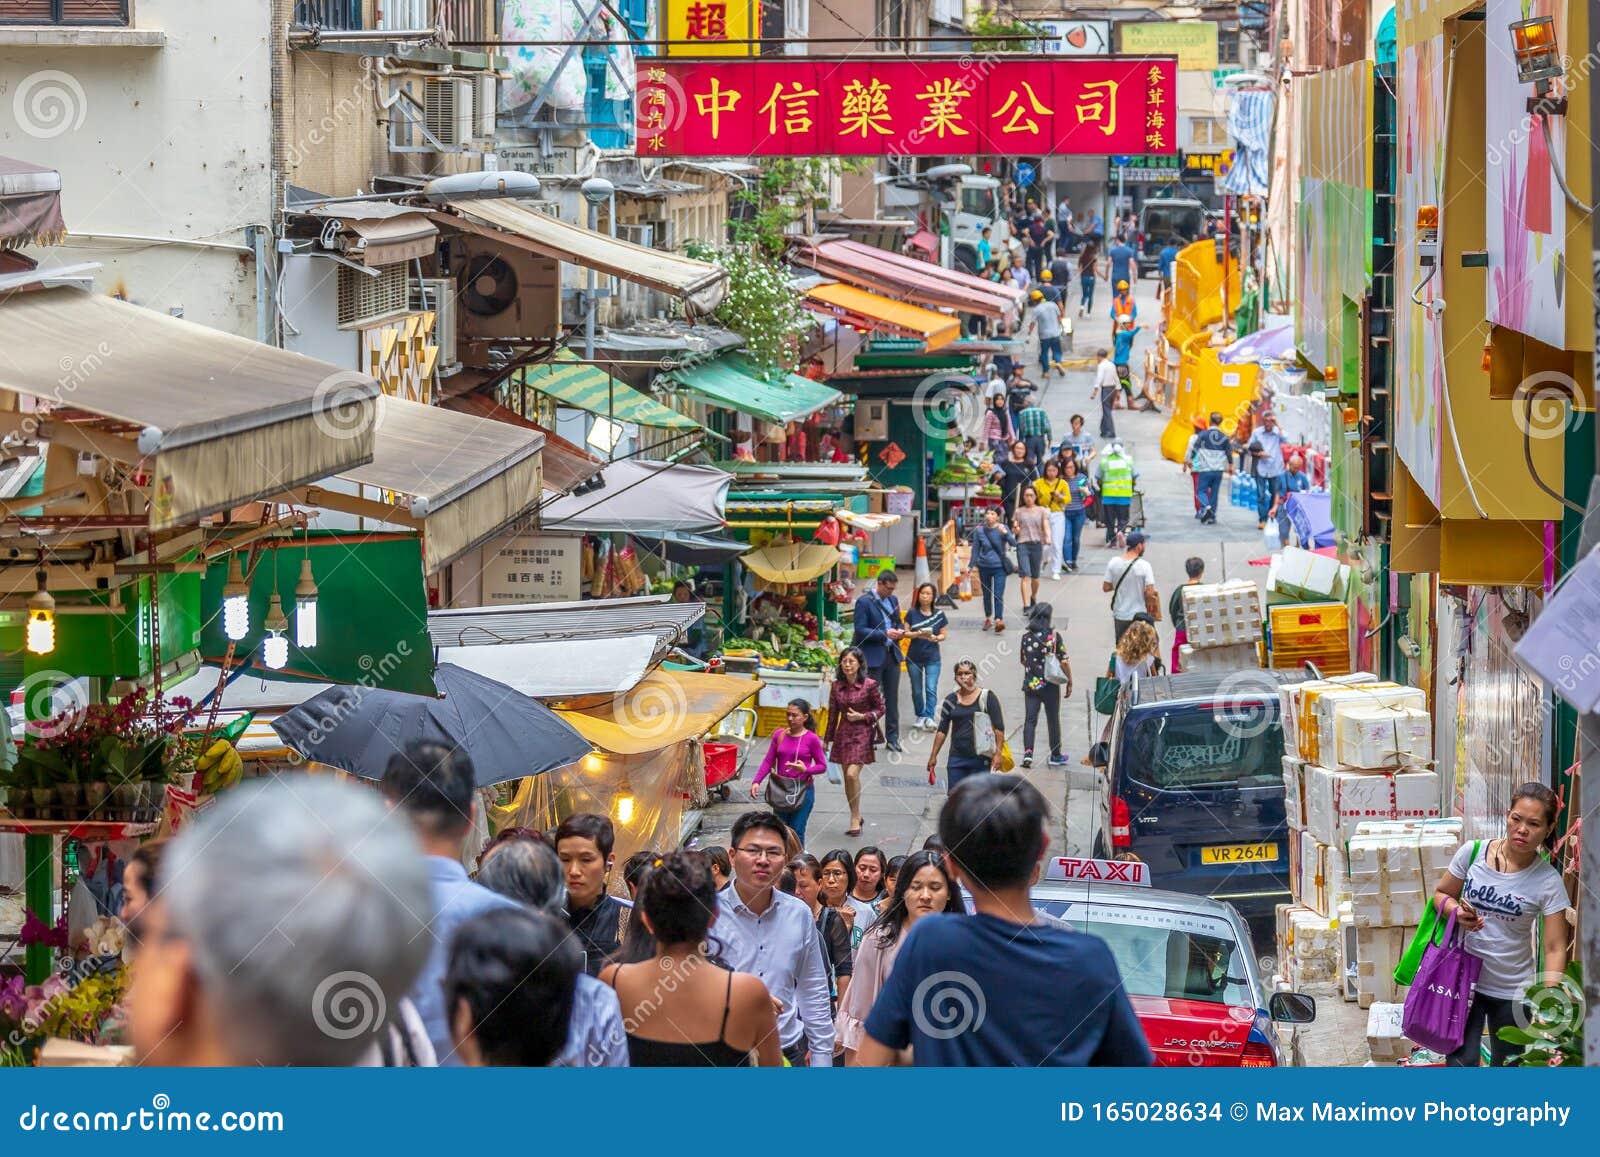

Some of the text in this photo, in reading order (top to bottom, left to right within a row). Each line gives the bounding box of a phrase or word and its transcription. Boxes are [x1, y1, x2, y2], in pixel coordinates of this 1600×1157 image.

[687, 2, 728, 39] 超
[693, 77, 1119, 140] 中信藥業公司
[1211, 845, 1268, 861] VR 2641
[1058, 858, 1144, 883] TAXI
[1464, 879, 1522, 914] Hollister
[1164, 1037, 1187, 1047] LPG
